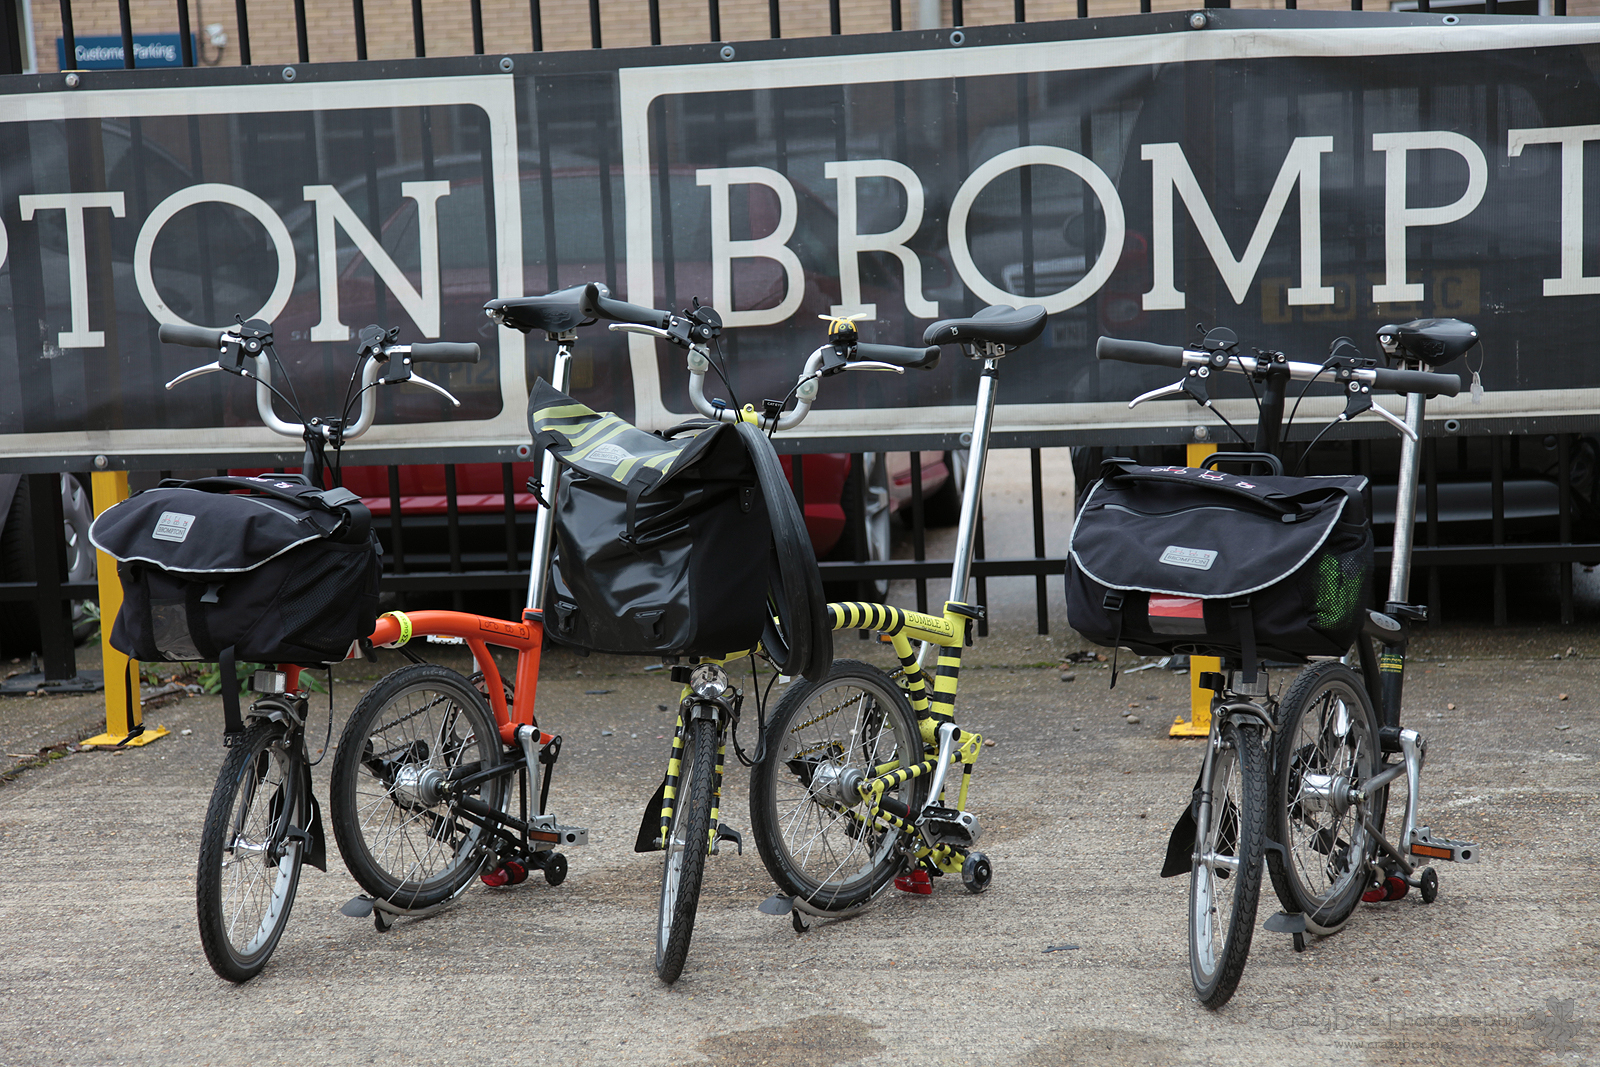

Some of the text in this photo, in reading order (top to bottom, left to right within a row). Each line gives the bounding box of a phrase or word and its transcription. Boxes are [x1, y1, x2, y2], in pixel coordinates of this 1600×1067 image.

[75, 42, 176, 61] Custome Parking
[0, 179, 451, 349] TON
[1167, 555, 1208, 565] BROMPTON
[908, 611, 942, 629] BUMBLE
